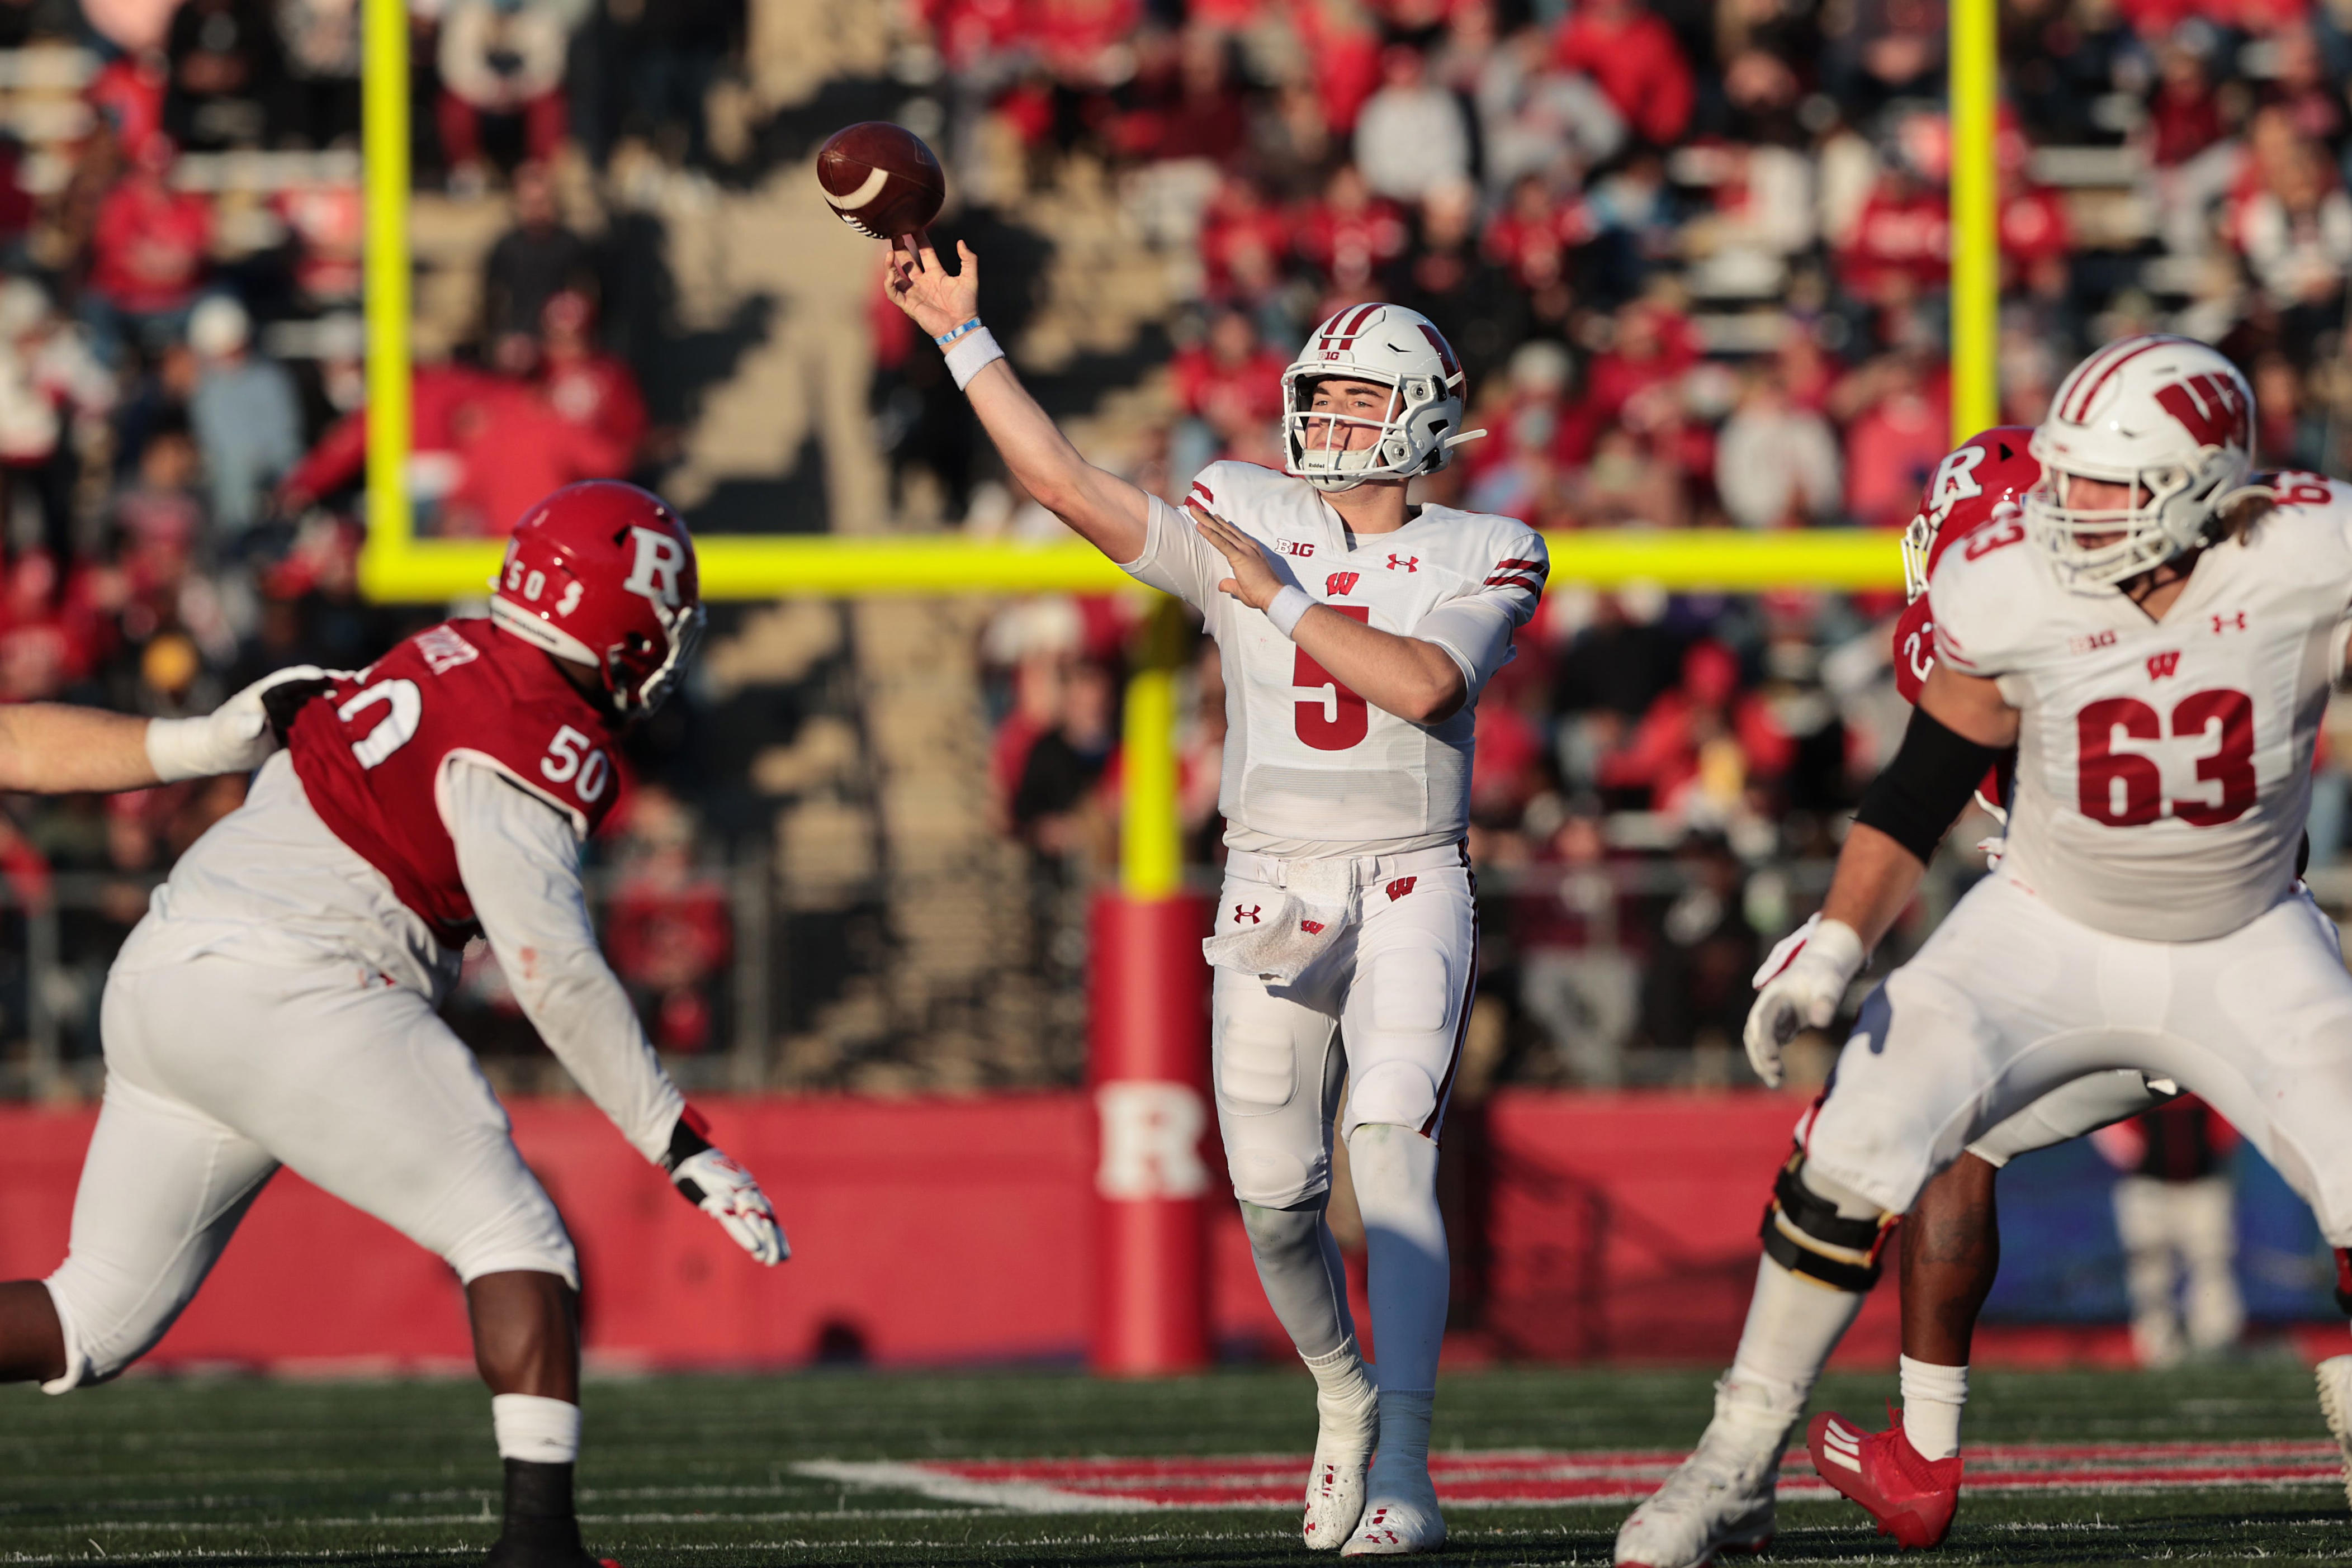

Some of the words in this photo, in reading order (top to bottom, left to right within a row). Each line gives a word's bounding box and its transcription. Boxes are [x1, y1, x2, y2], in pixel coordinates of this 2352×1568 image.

[1929, 446, 1986, 511] R
[506, 560, 546, 601] 50
[623, 525, 686, 607] R
[1326, 572, 1360, 596] W
[1293, 605, 1369, 750] 5
[1903, 622, 1935, 683] 2
[2147, 651, 2180, 681] W
[540, 724, 608, 803] 50
[2077, 689, 2256, 827] 63
[1386, 876, 1417, 902] W
[1301, 920, 1325, 935] W
[1092, 1080, 1211, 1201] R
